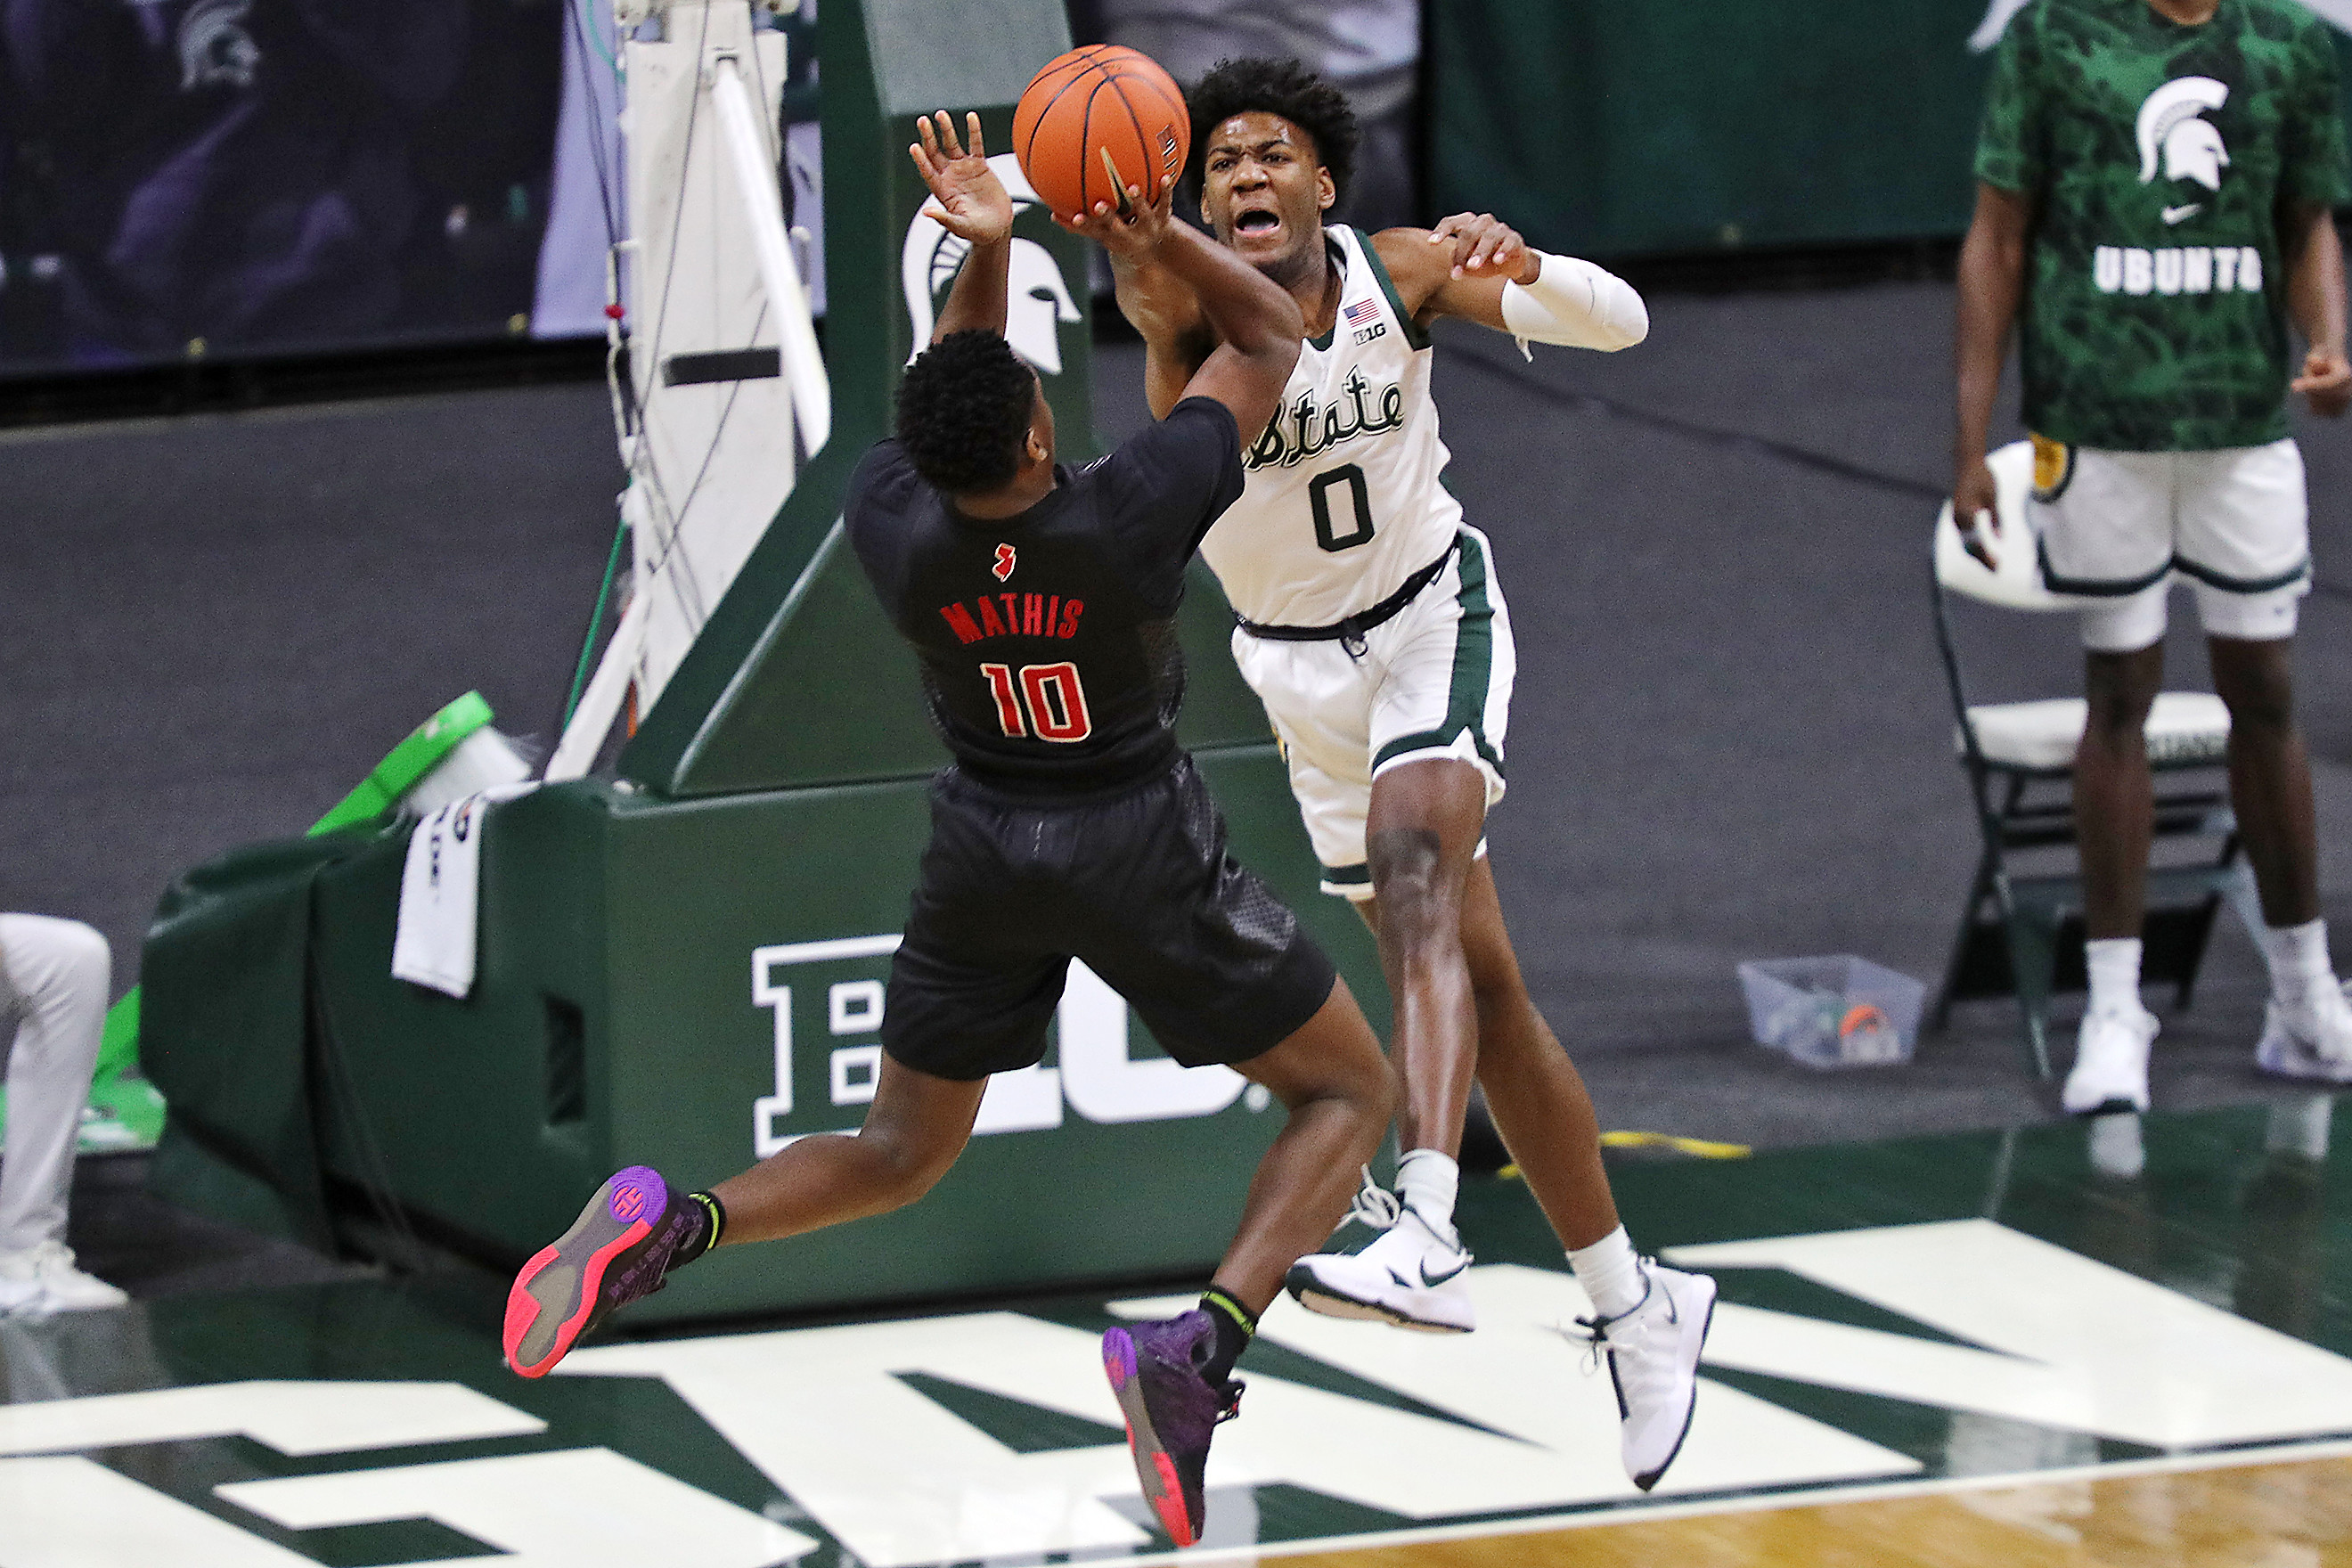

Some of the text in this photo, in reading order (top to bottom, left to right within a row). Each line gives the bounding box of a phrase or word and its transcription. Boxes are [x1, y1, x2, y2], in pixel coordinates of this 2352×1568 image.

[1241, 364, 1404, 472] State
[1309, 462, 1375, 552] 0
[940, 592, 1084, 645] MATHIS
[979, 661, 1091, 743] 10
